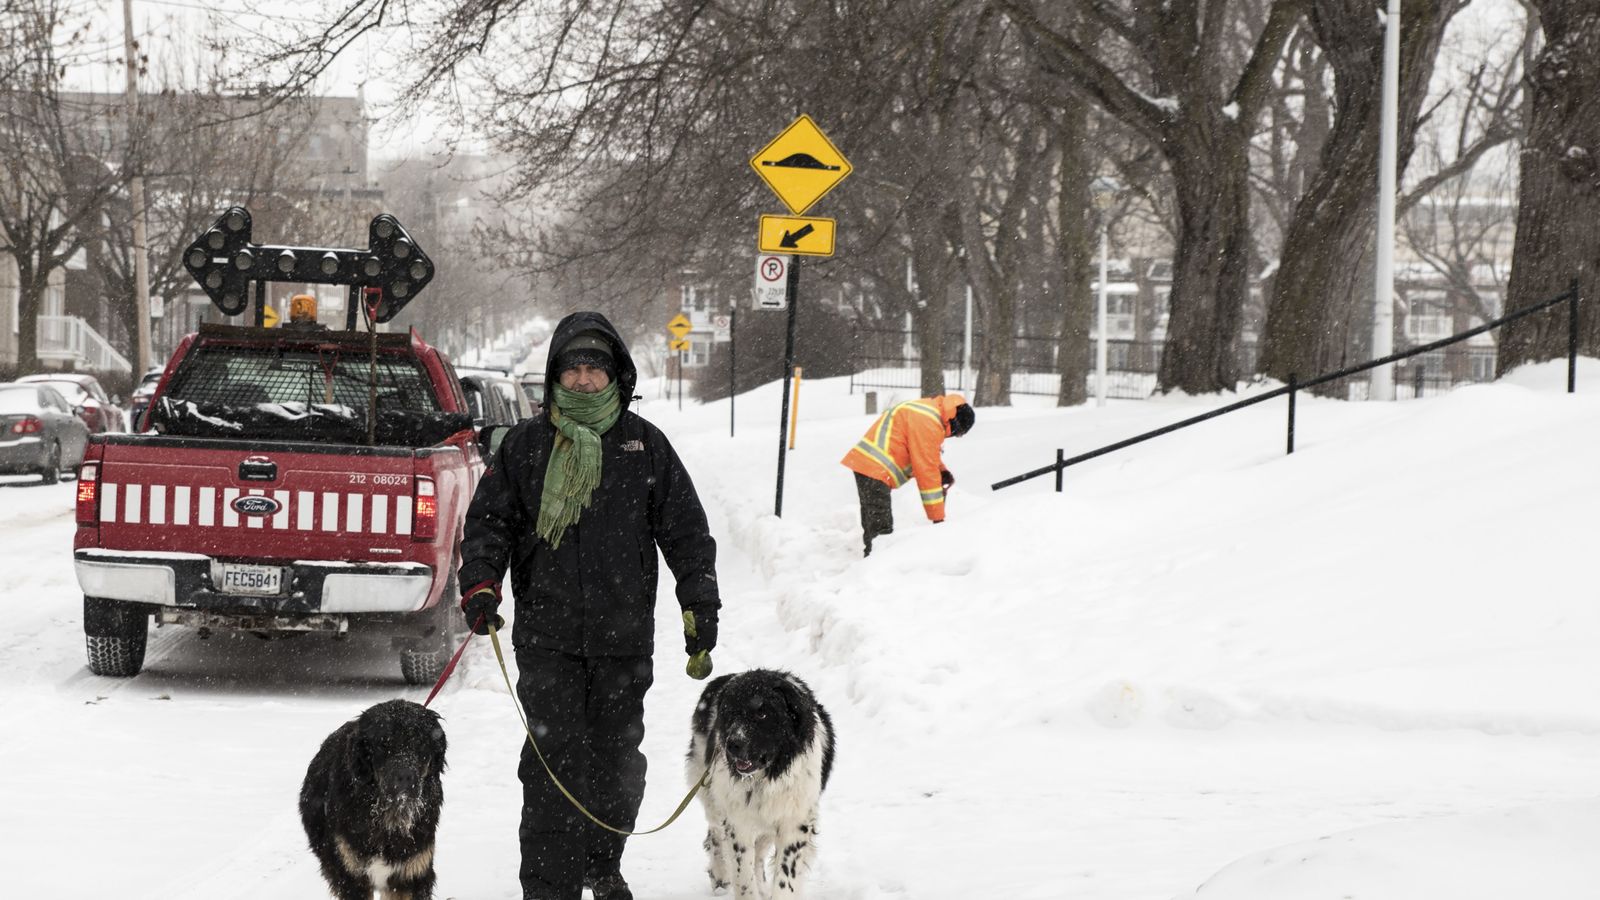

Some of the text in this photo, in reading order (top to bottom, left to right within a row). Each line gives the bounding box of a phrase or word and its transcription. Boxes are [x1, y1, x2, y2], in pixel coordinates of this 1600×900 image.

[349, 474, 408, 485] 212 08024
[243, 499, 268, 511] Ford
[225, 571, 278, 588] FEC5841
